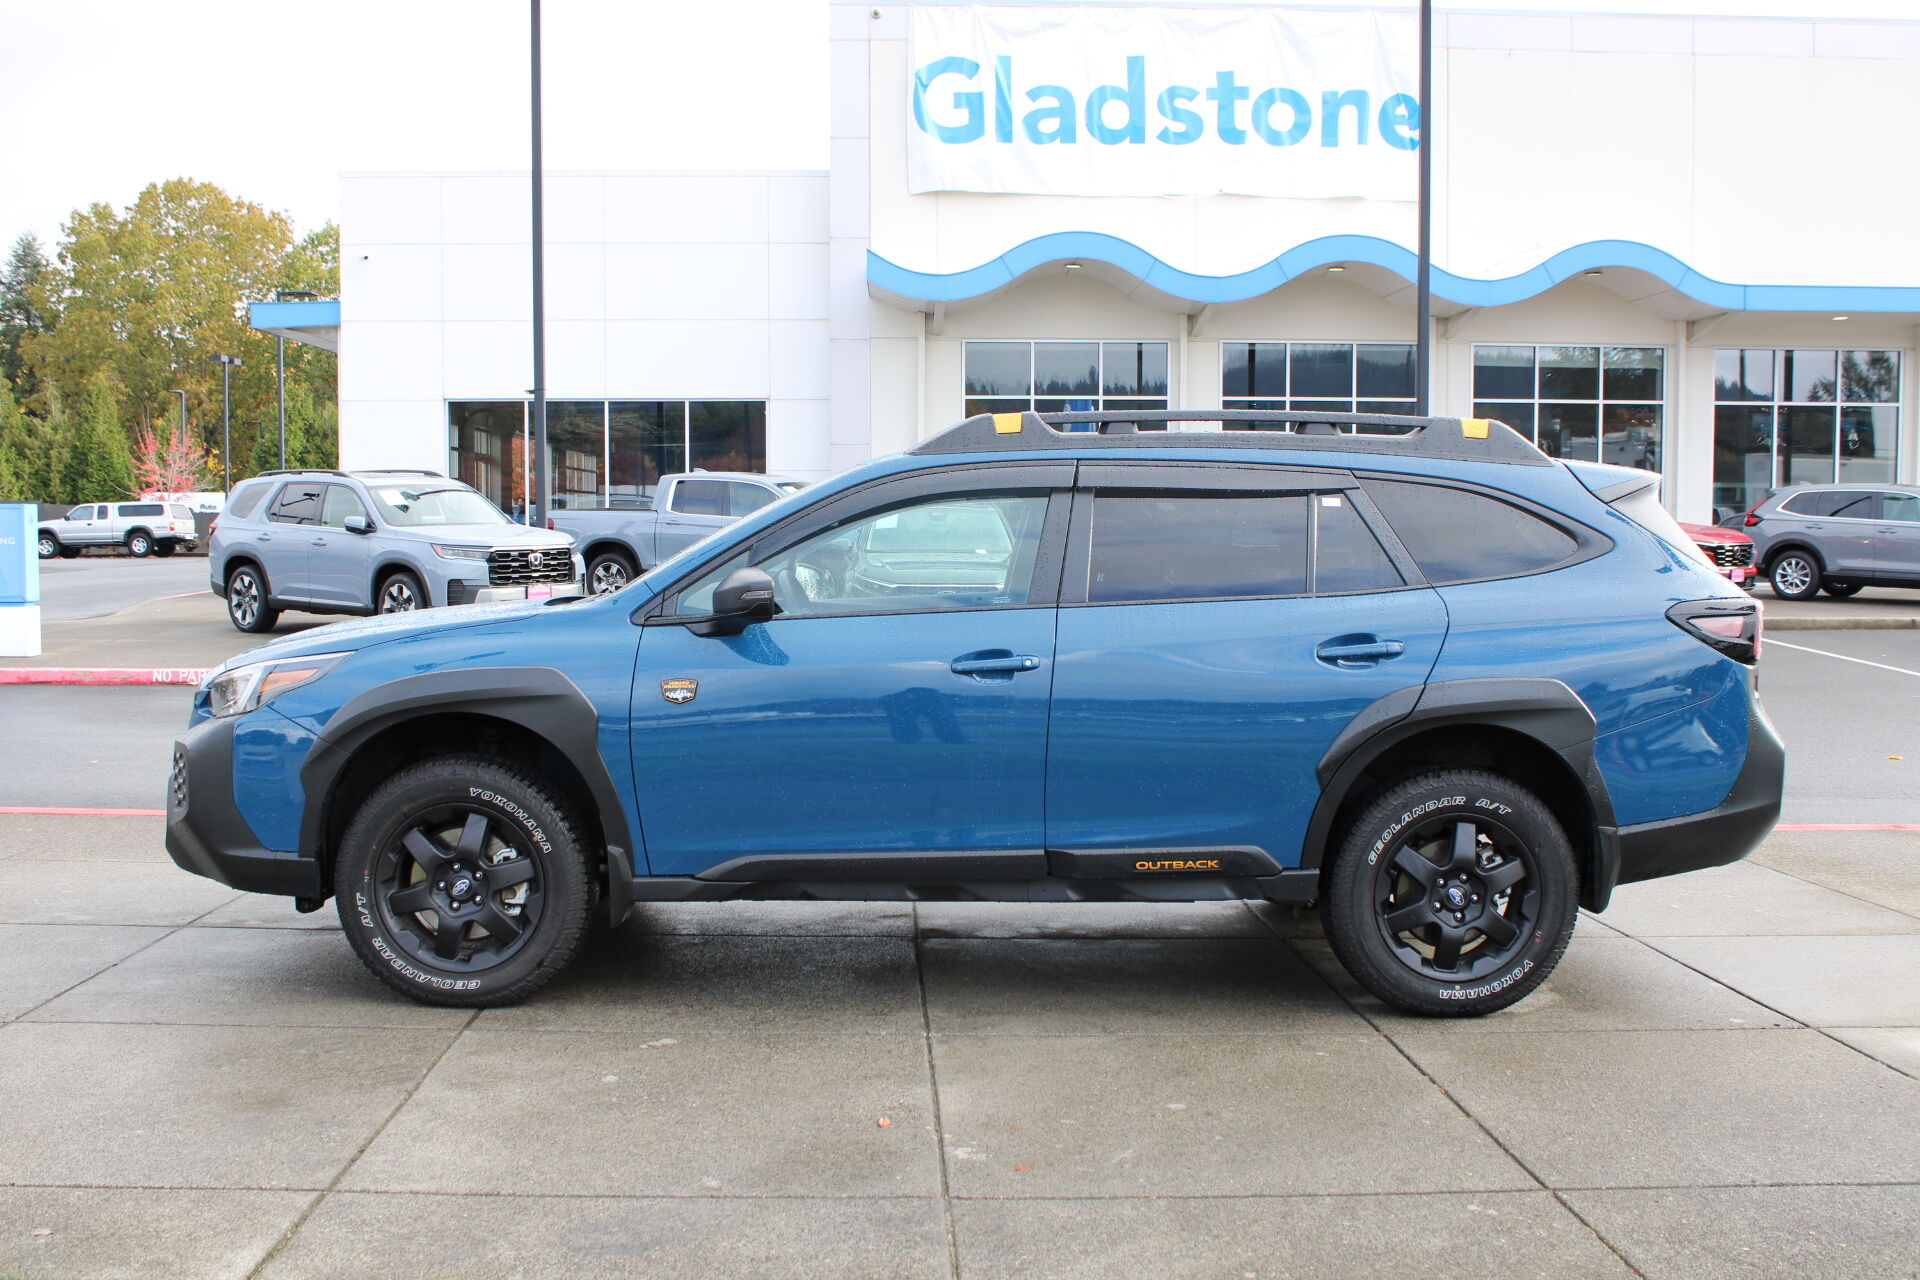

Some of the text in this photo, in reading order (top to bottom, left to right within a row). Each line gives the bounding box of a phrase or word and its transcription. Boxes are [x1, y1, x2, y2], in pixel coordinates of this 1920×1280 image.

[913, 55, 1421, 151] Gladstone
[153, 670, 172, 682] NO
[469, 787, 552, 854] YOKOHAMA
[1367, 796, 1512, 865] GEOLANDAR A/T
[1135, 860, 1219, 870] OUTBACK
[356, 892, 481, 990] GEOLANDAR A/T
[1439, 959, 1534, 999] YOKOHAMA
